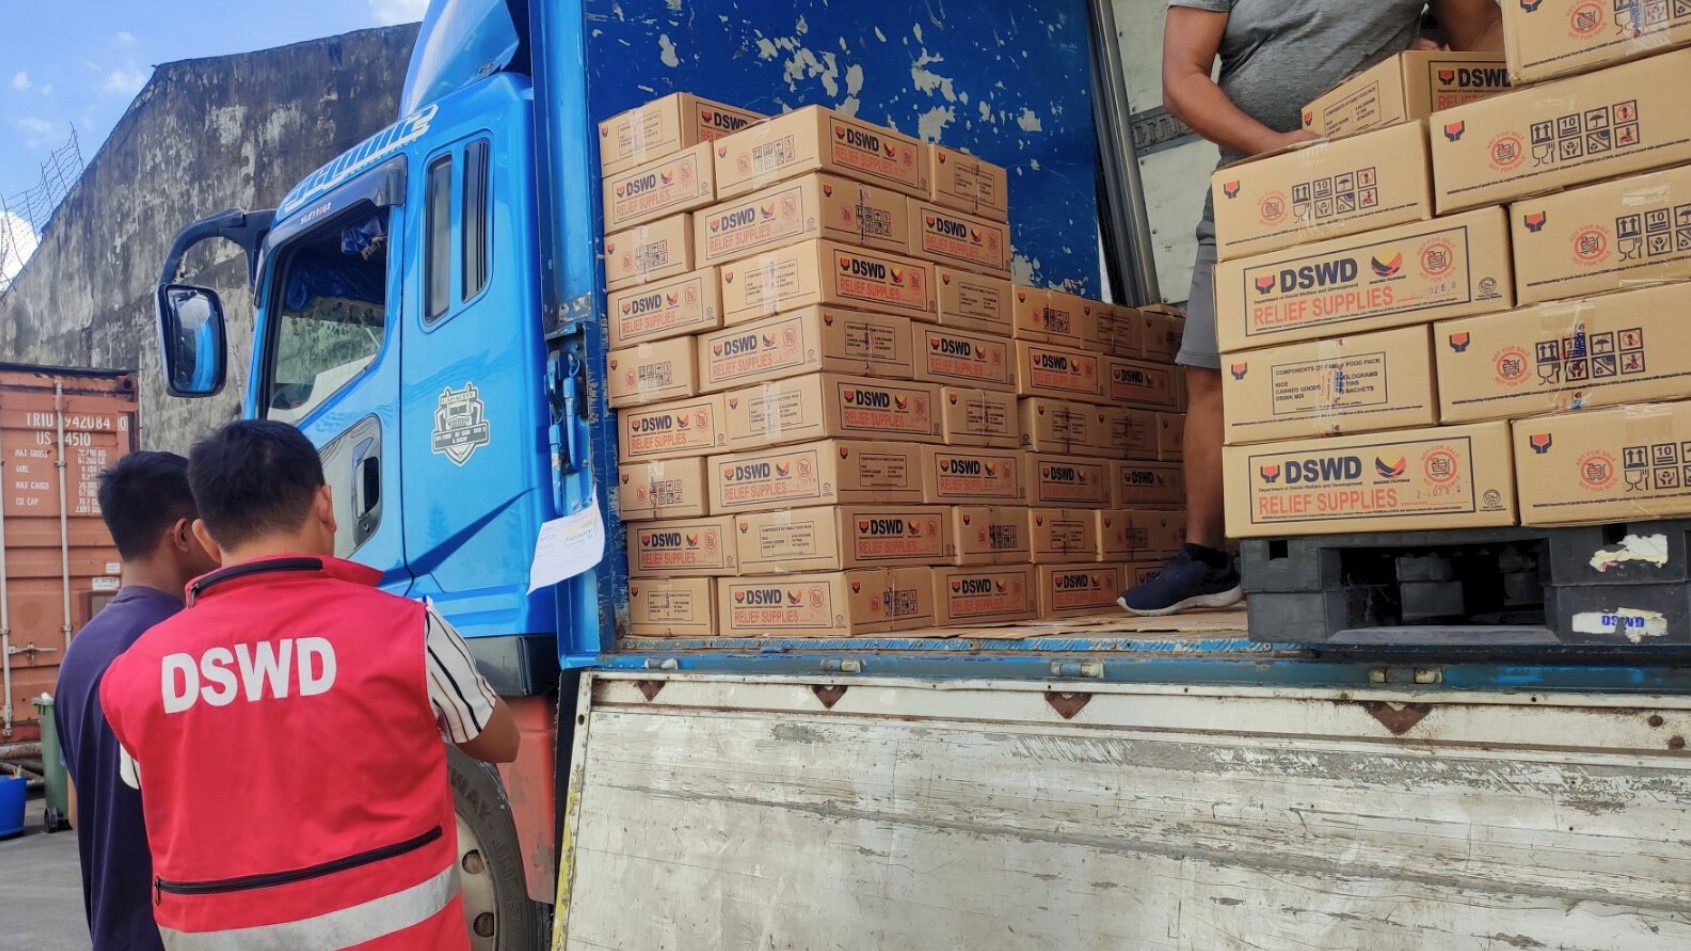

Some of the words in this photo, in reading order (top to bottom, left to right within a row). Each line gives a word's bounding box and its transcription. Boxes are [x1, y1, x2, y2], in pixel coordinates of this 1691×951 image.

[1562, 118, 1575, 127] 10
[847, 129, 879, 152] DSWD
[626, 174, 656, 196] DSWD
[1317, 182, 1328, 190] 10
[616, 202, 638, 219] RELIEF
[639, 191, 671, 210] SUPPLIES
[721, 208, 755, 230] DSWD
[1651, 212, 1665, 222] 10
[936, 218, 967, 238] DSWD
[709, 233, 734, 251] RELIEF
[736, 224, 771, 244] SUPPLIES
[852, 259, 886, 279] DSWD
[1280, 258, 1357, 293] DSWD
[840, 279, 866, 294] RELIEF
[867, 283, 900, 299] SUPPLIES
[632, 294, 662, 313] DSWD
[1254, 300, 1307, 326] RELIEF
[1312, 286, 1393, 316] SUPPLIES
[622, 318, 643, 333] RELIEF
[644, 311, 675, 328] SUPPLIES
[724, 335, 757, 355] DSWD
[941, 339, 971, 356] DSWD
[712, 361, 736, 378] RELIEF
[738, 354, 772, 372] SUPPLIES
[1042, 354, 1067, 370] DSWD
[1276, 366, 1314, 375] COMPONENTS
[856, 391, 890, 407] DSWD
[1276, 387, 1298, 395] CANNED
[27, 412, 53, 427] TRIU
[64, 416, 110, 429] 942084
[642, 415, 672, 431] DSWD
[844, 412, 869, 424] RELIEF
[871, 413, 904, 427] SUPPLIES
[36, 432, 51, 445] US
[65, 432, 91, 446] 4510
[631, 436, 653, 450] RELIEF
[655, 433, 686, 447] SUPPLIES
[1656, 446, 1672, 456] 10
[736, 463, 770, 480] DSWD
[951, 460, 980, 474] DSWD
[1285, 456, 1362, 484] DSWD
[16, 481, 28, 489] MAX
[724, 485, 749, 500] RELIEF
[751, 482, 786, 496] SUPPLIES
[1258, 494, 1312, 515] RELIEF
[1317, 488, 1397, 511] SUPPLIES
[871, 520, 903, 534] DSWD
[651, 533, 681, 547] DSWD
[642, 553, 663, 565] RELIEF
[665, 552, 695, 563] SUPPLIES
[962, 579, 991, 594] DSWD
[1064, 575, 1088, 588] DSWD
[746, 590, 782, 604] DSWD
[735, 612, 760, 623] RELIEF
[762, 610, 798, 622] SUPPLIES
[161, 636, 337, 714] DSWD
